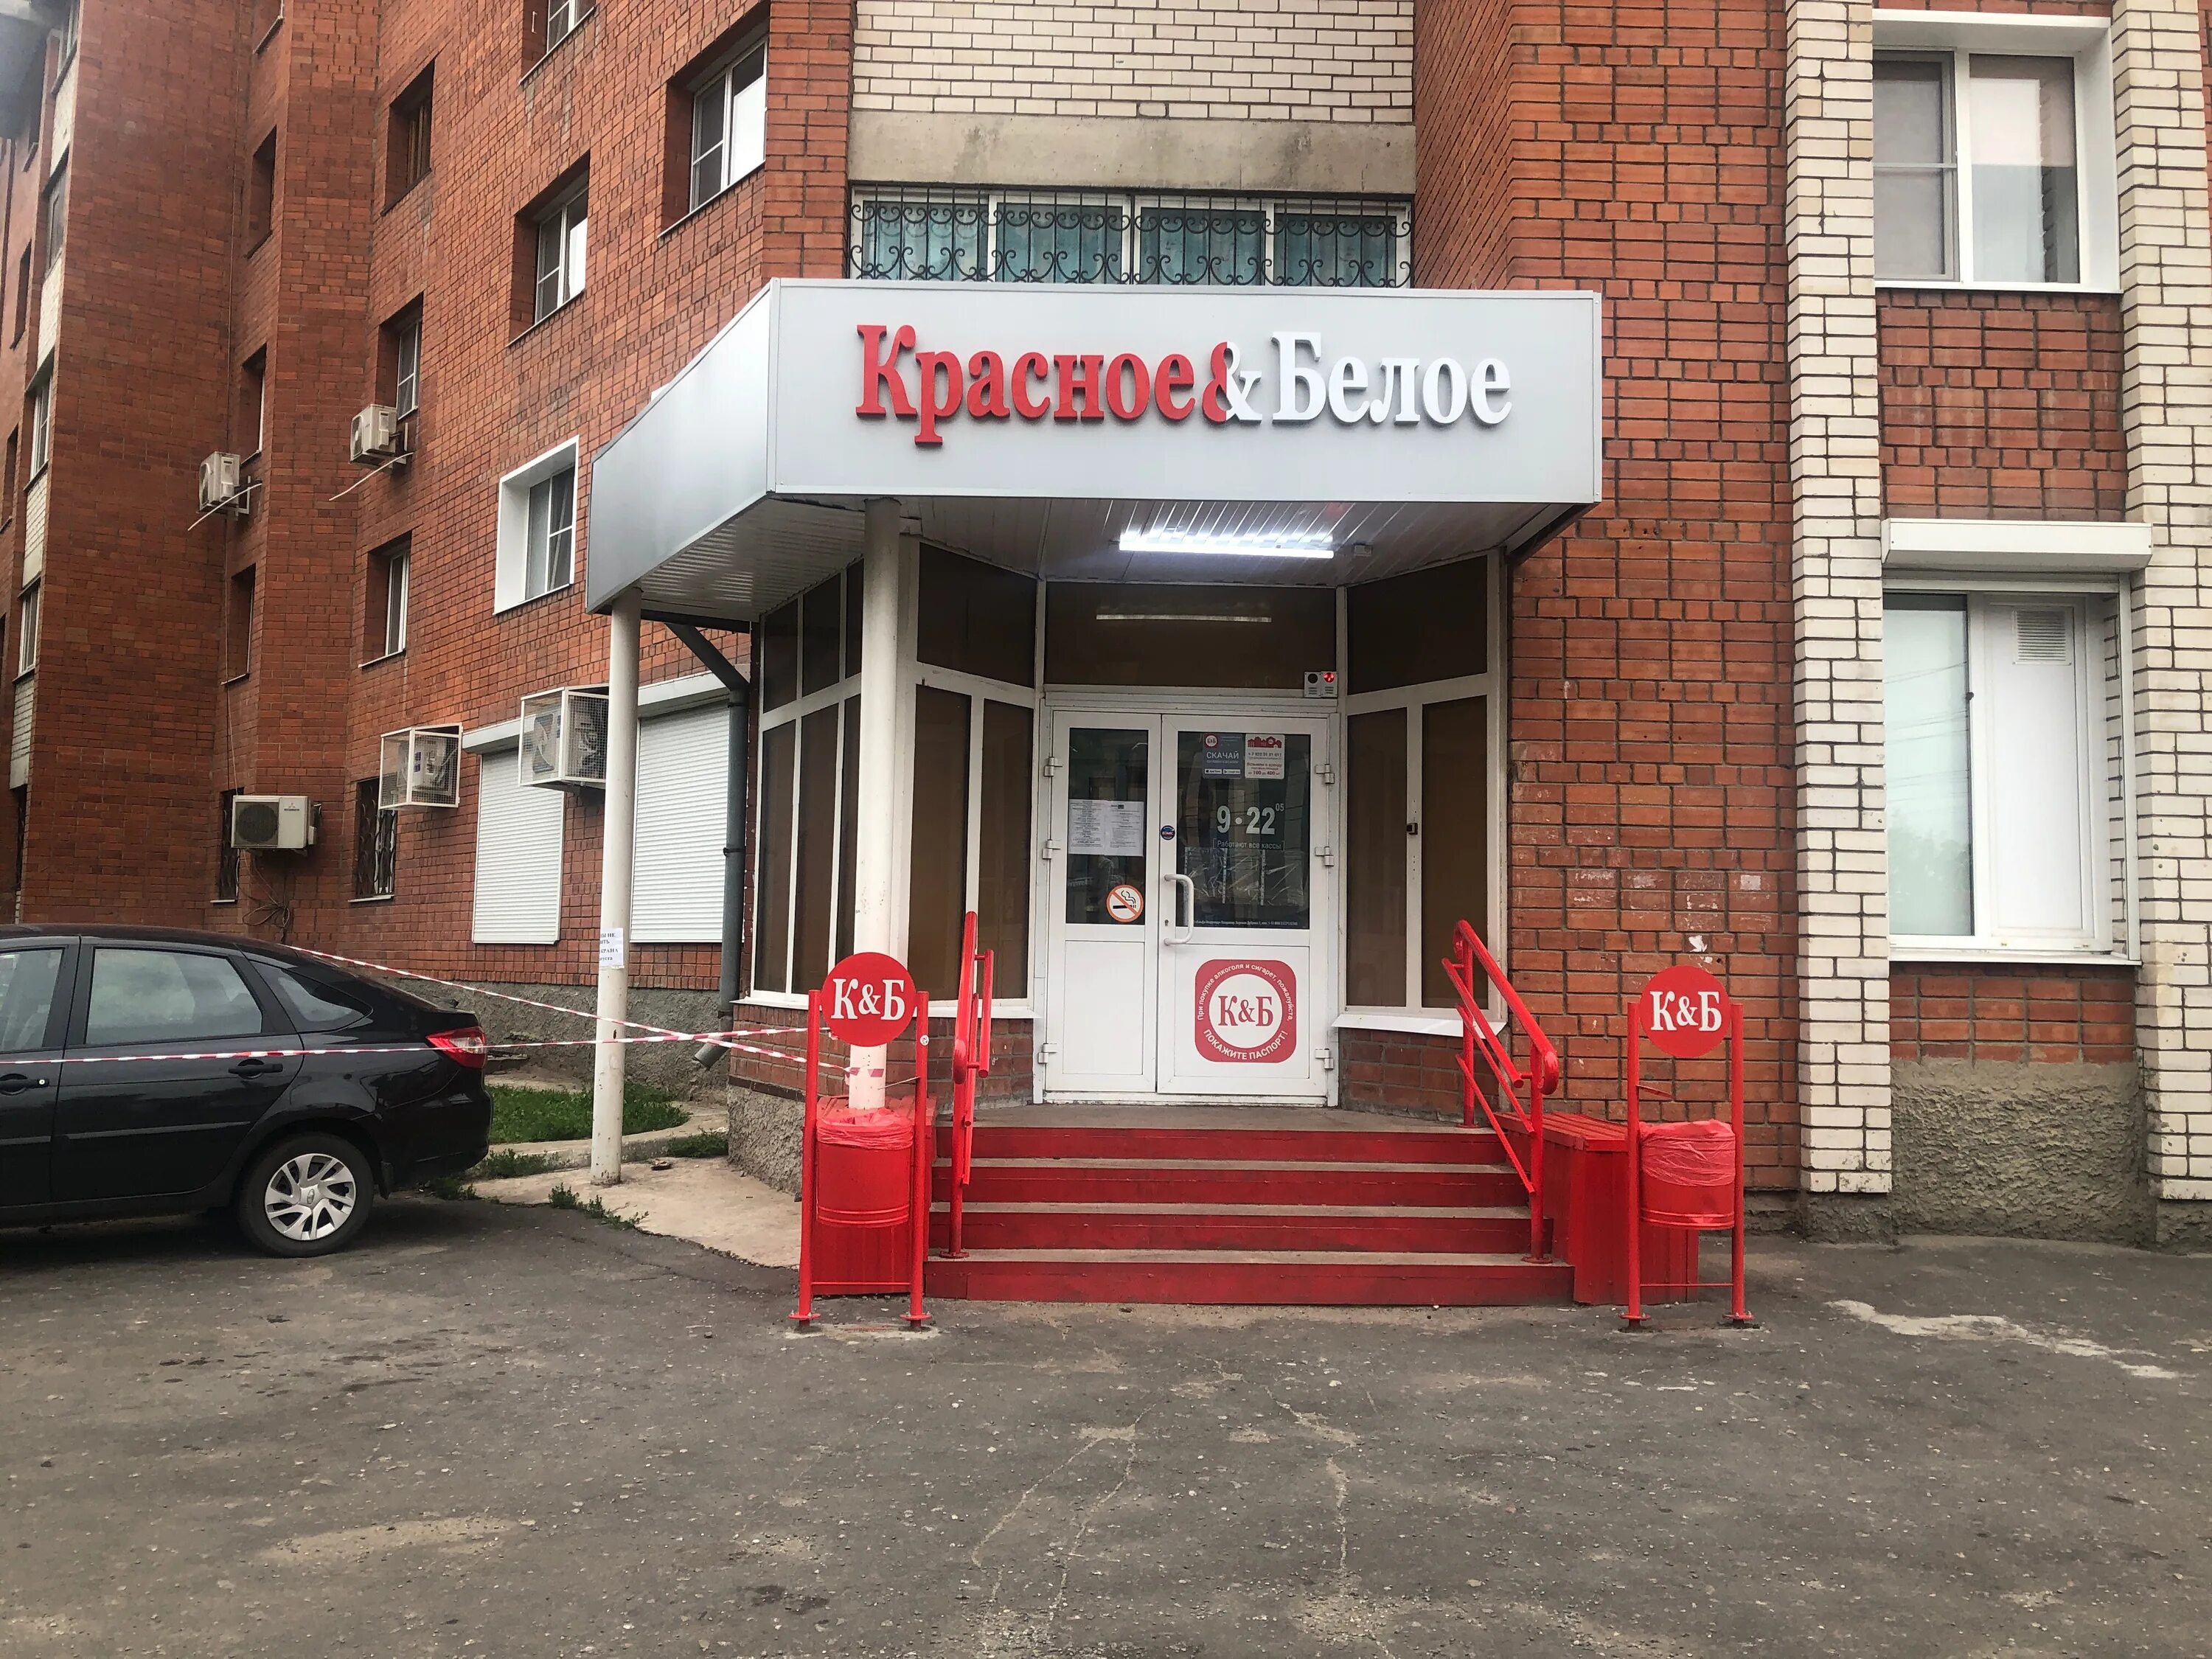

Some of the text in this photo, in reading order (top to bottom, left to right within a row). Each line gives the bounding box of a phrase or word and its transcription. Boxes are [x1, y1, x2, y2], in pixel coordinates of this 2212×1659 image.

[1206, 751, 1239, 759] СКАЧАЙ
[1276, 803, 1284, 812] 05
[1214, 964, 1244, 980] алкоголя
[1251, 964, 1277, 981] сигарет,
[830, 978, 906, 1020] К&Б
[1199, 978, 1215, 1005] покупке
[1276, 979, 1295, 1021] пожалуйста,
[1197, 1006, 1205, 1020] При
[1218, 995, 1274, 1026] К&Б
[1649, 991, 1722, 1032] К&Б
[1203, 1029, 1288, 1060] ПОКАЖИТЕ ПАСПОРТ!
